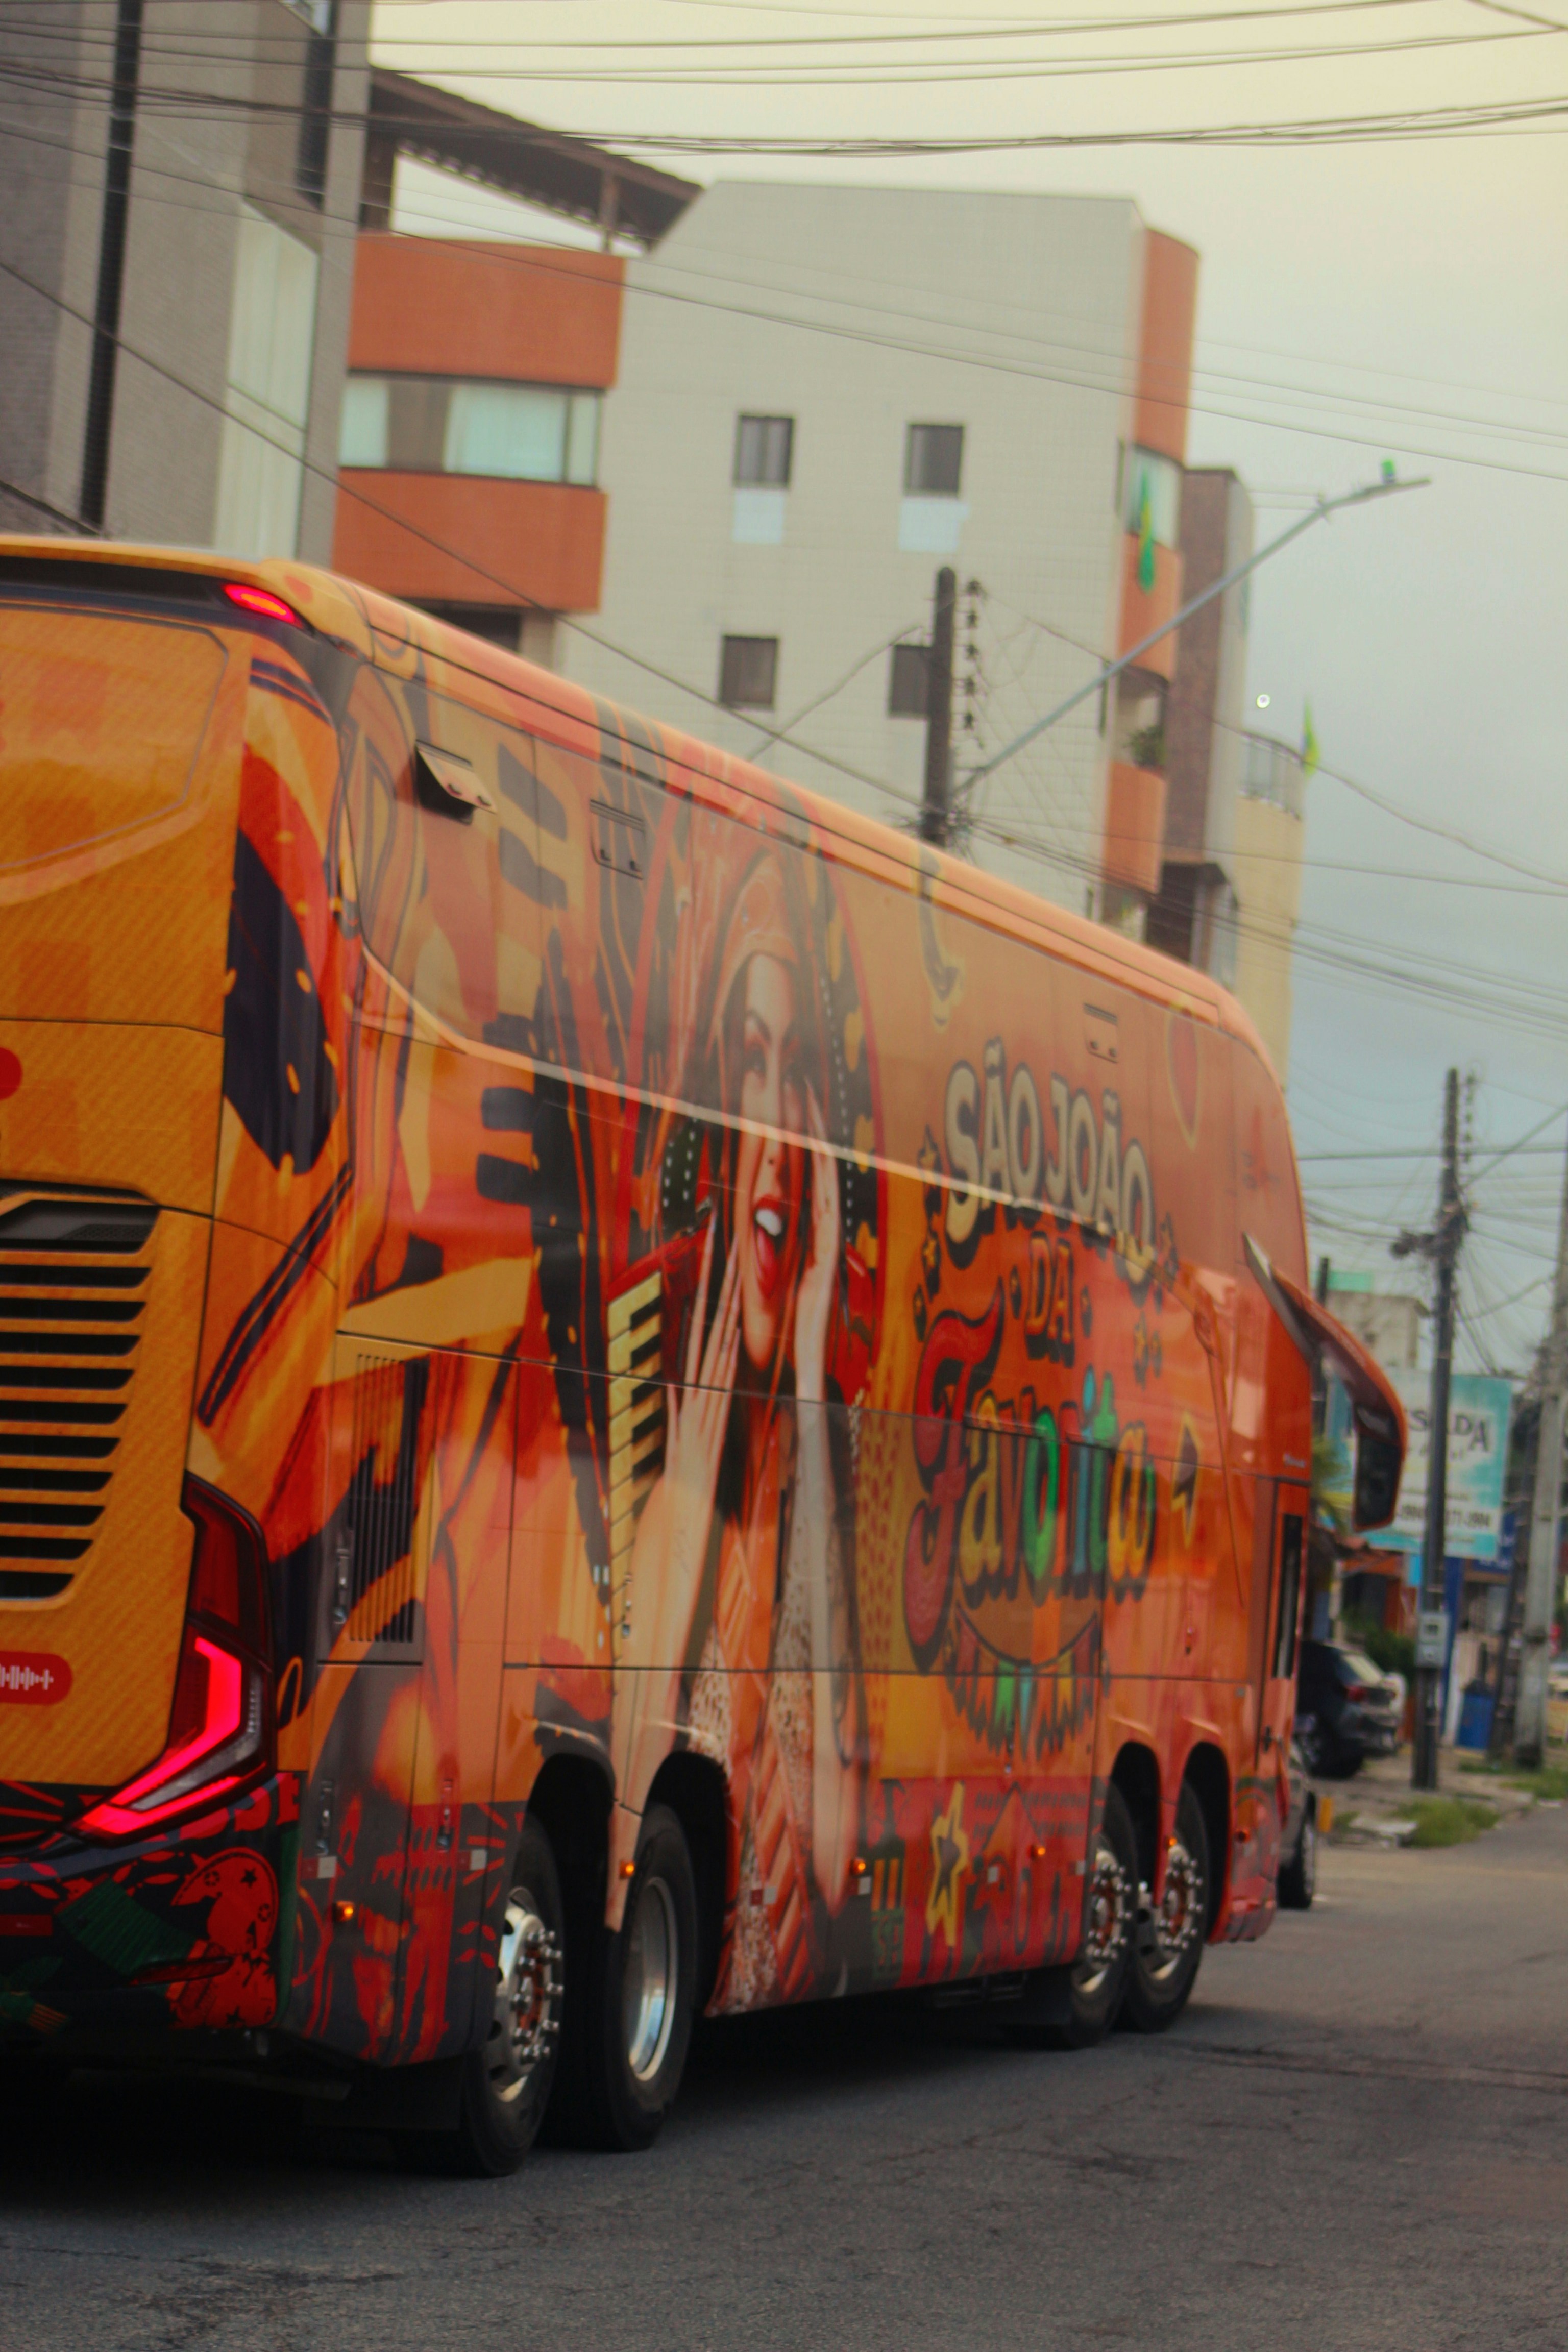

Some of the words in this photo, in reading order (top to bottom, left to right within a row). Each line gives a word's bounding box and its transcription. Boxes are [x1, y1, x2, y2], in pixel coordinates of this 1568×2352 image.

[944, 1036, 1044, 1253] SÃO
[1044, 1073, 1156, 1286] JOÃO
[1026, 1231, 1073, 1348] DA
